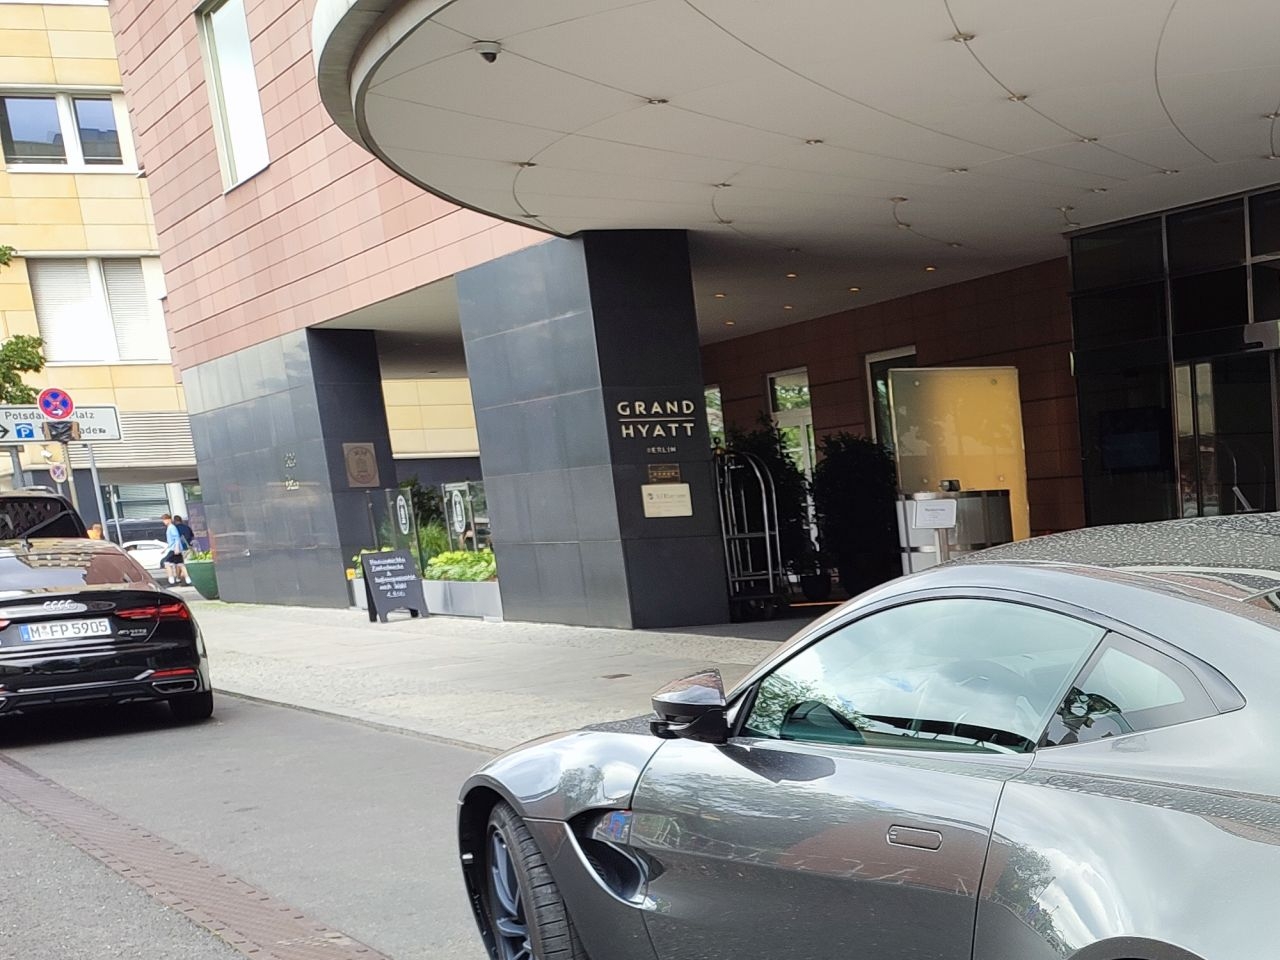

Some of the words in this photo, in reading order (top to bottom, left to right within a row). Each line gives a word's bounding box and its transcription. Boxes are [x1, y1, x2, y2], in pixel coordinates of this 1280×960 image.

[617, 400, 694, 415] GRAND
[4, 411, 48, 420] Potsda
[621, 423, 694, 438] HYATT
[30, 625, 41, 639] M
[49, 624, 69, 637] FP
[73, 620, 108, 635] 5905
